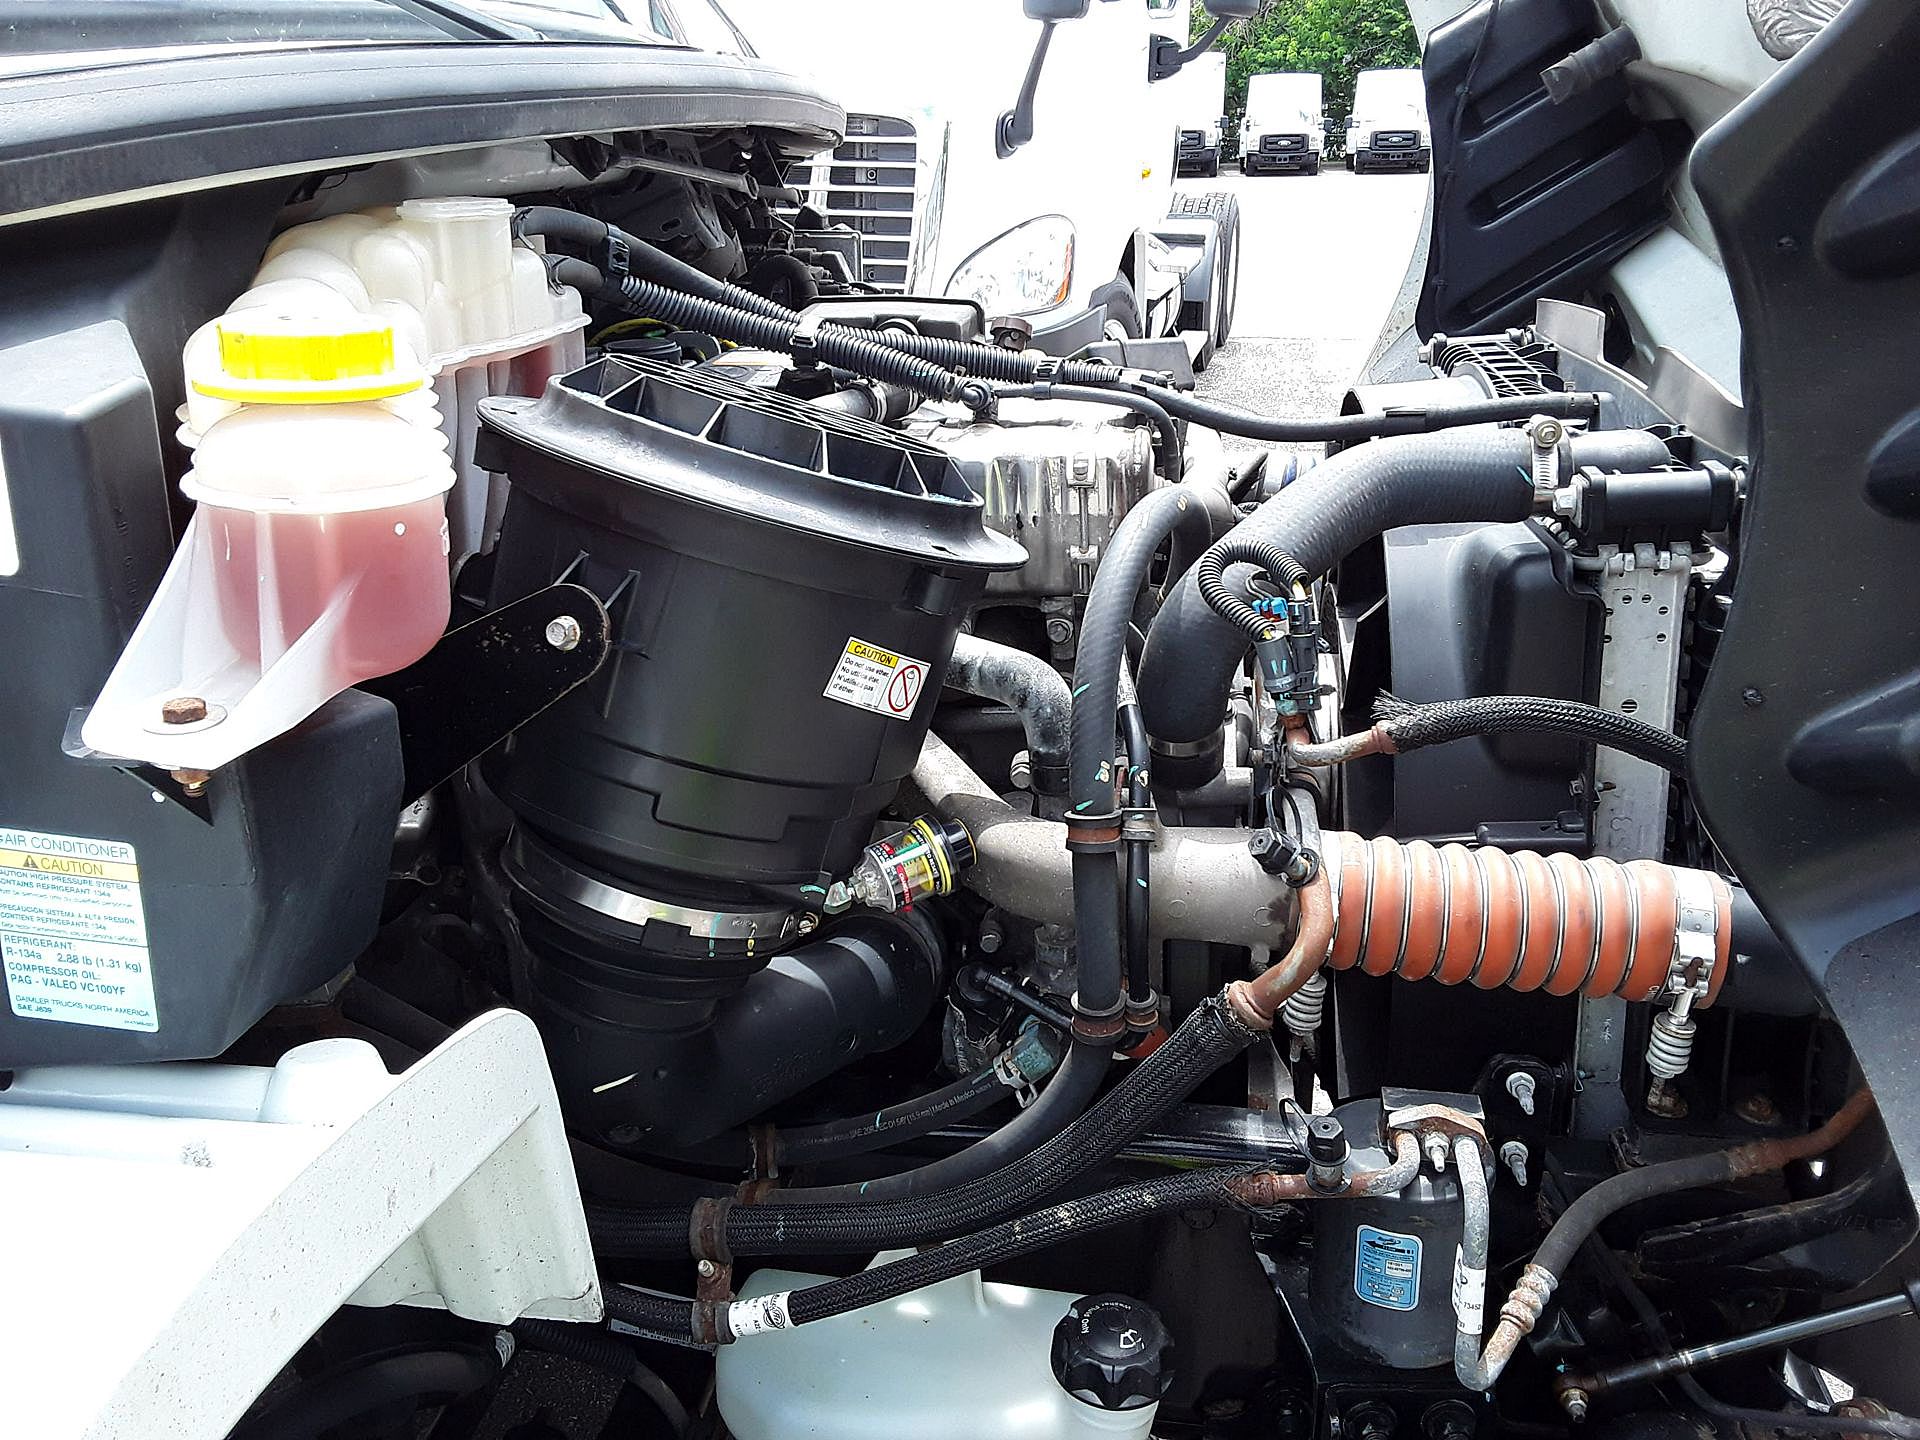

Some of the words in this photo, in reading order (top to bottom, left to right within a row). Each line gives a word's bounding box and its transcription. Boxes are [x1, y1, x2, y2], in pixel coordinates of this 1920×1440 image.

[854, 645, 892, 664] CAUTION
[5, 834, 26, 846] AIR
[31, 837, 129, 858] CONDITIONER
[41, 858, 104, 876] CAUTION
[0, 870, 28, 878] AUTION
[30, 872, 49, 880] HIGH
[52, 876, 94, 886] PRESSURE
[0, 878, 34, 888] ONTAINS
[36, 883, 90, 894] REFRIGERANT
[0, 912, 35, 922] CONTIENE
[4, 934, 76, 950] REFRIGERANT:
[6, 947, 42, 960] R-134a
[57, 953, 79, 964] 2.88
[82, 956, 92, 966] lb
[96, 958, 120, 969] (1.31
[124, 960, 142, 973] kg)
[8, 962, 78, 978] COMPRESSOR
[10, 974, 32, 984] PAG
[42, 977, 77, 990] VALEO
[80, 982, 126, 995] VC100YF
[16, 995, 50, 1006] DAIMLER
[51, 998, 83, 1010] TRUCKS
[85, 1003, 112, 1012] NORTH
[115, 1007, 150, 1017] AMERICA
[932, 1101, 949, 1113] Made
[954, 1090, 975, 1103] Mexico
[1081, 1318, 1089, 1334] Only
